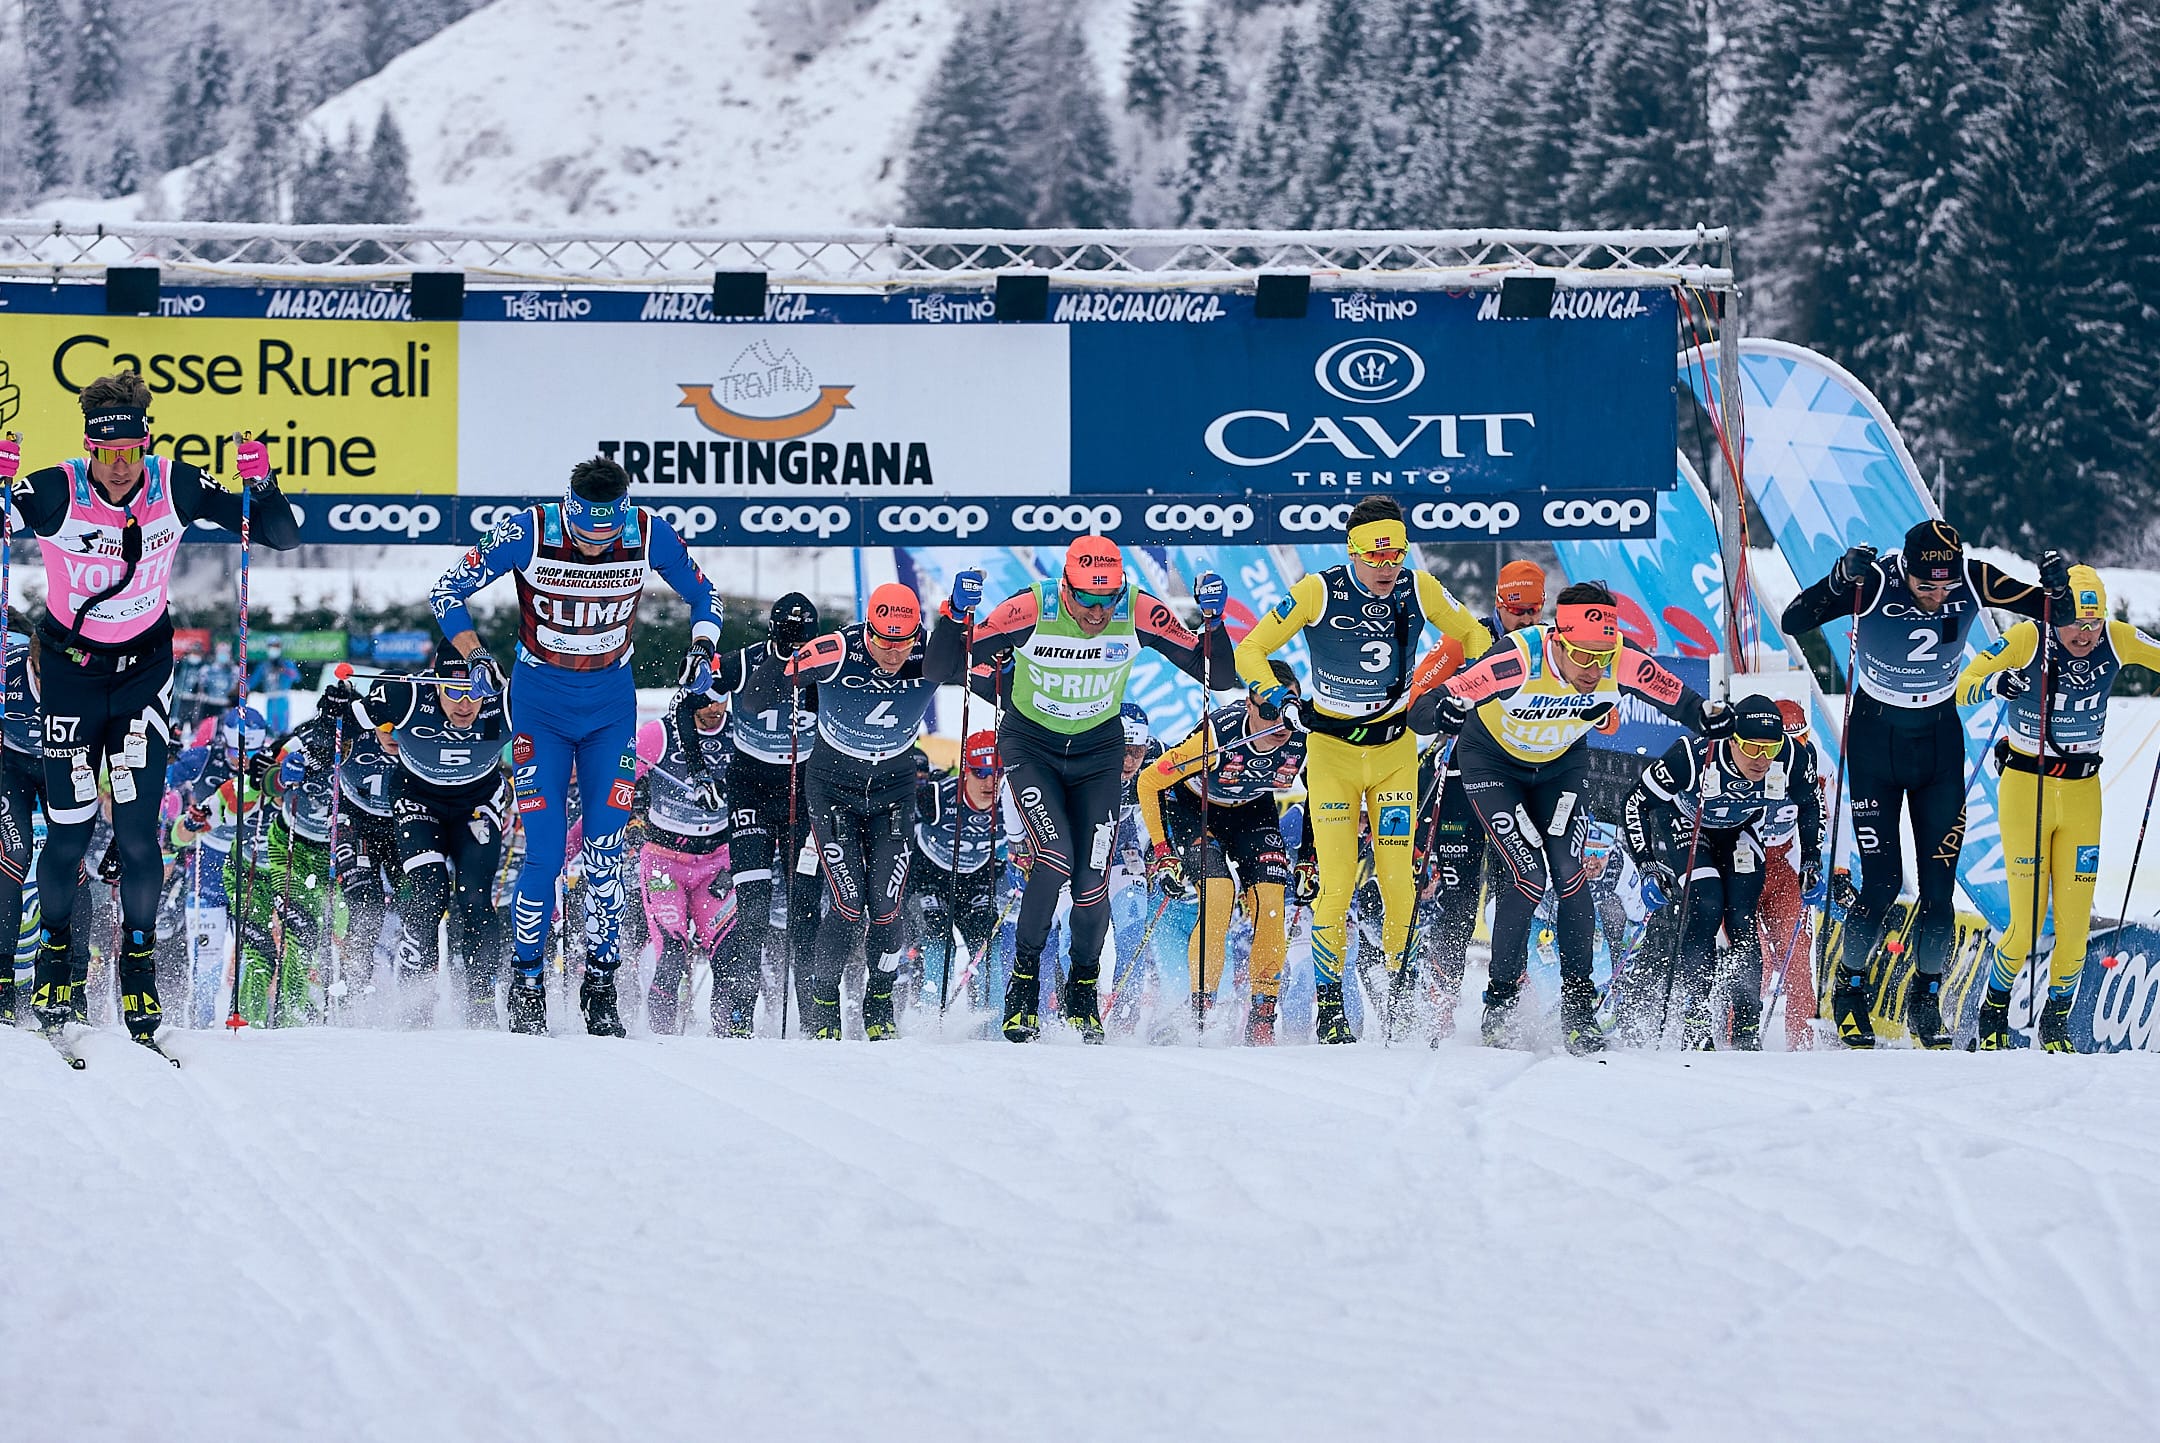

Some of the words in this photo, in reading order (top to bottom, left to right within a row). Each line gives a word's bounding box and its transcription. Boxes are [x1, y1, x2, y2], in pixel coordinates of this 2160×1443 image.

[138, 294, 205, 317] TINO
[266, 289, 421, 321] MARCIALONG
[503, 294, 591, 321] TRENTINO
[640, 292, 815, 322] MARCNGA
[908, 295, 995, 322] TRENTINO
[1053, 294, 1226, 322] MARCIALONGA
[1332, 294, 1417, 322] TRENTINO
[1477, 290, 1647, 321] MALONGA
[258, 338, 431, 398] Rurali
[147, 415, 376, 477] rentine
[1204, 409, 1535, 467] CAVIT
[599, 440, 933, 486] TRENTINGRANA
[1292, 471, 1451, 486] TRENTO
[328, 504, 441, 538] coop
[739, 505, 851, 539] coop
[877, 504, 989, 538] coop
[1011, 504, 1122, 536] coop
[1144, 504, 1255, 538] coop
[1279, 504, 1352, 532] coo
[1411, 501, 1520, 535] coop
[1543, 499, 1651, 533] coop
[98, 543, 123, 558] LIVI
[151, 532, 175, 551] LEVI
[1920, 550, 1954, 561] XPND
[534, 566, 562, 578] SHOP
[562, 567, 631, 580] MERCHANDISE
[631, 567, 644, 578] AT
[536, 575, 642, 589] VISMASKICLASSICS.COM
[532, 593, 637, 628] CLIMB
[890, 605, 914, 615] RAGDE
[1881, 600, 1968, 619] CAIT
[1329, 615, 1396, 633] CAV
[1033, 645, 1077, 659] WATCH
[1075, 647, 1102, 660] LIVE
[1359, 640, 1393, 673] 3
[1906, 628, 1940, 662] 2
[1323, 671, 1379, 686] MARCIALONGA
[1872, 658, 1926, 675] MARCIALONGA
[2057, 660, 2111, 685] AVIT
[841, 675, 927, 690] CAVIT
[1027, 662, 1130, 699] SPRINT
[2059, 681, 2097, 691] TRENTO
[864, 700, 899, 729] 4
[1509, 708, 1547, 720] SIGN
[1548, 708, 1566, 719] UP
[1528, 694, 1595, 708] MYPAGES
[44, 715, 81, 742] 157
[1500, 714, 1589, 746] CHAM
[2023, 710, 2076, 724] MARLONGA
[410, 726, 482, 741] CAVI
[44, 744, 91, 759] MOELVEN
[354, 752, 400, 765] CAV
[439, 748, 471, 766] 5
[1654, 759, 1675, 784] 157
[394, 798, 428, 815] 157
[520, 799, 541, 810] swix
[1377, 791, 1413, 803] ASKO
[731, 808, 757, 829] 157
[1027, 808, 1051, 845] Eiendom
[1035, 803, 1060, 841] RAGDE
[1670, 815, 1695, 832] 15
[1, 814, 24, 852] RAGDE
[1377, 838, 1410, 847] Koteng
[1439, 844, 1469, 854] FLOOR
[1502, 836, 1528, 875] Eiendom
[1508, 831, 1539, 872] RAGDE
[829, 865, 849, 901] Eiendom
[836, 861, 858, 900] RAGDE
[2073, 873, 2097, 883] Kote
[2093, 951, 2160, 1050] coo
